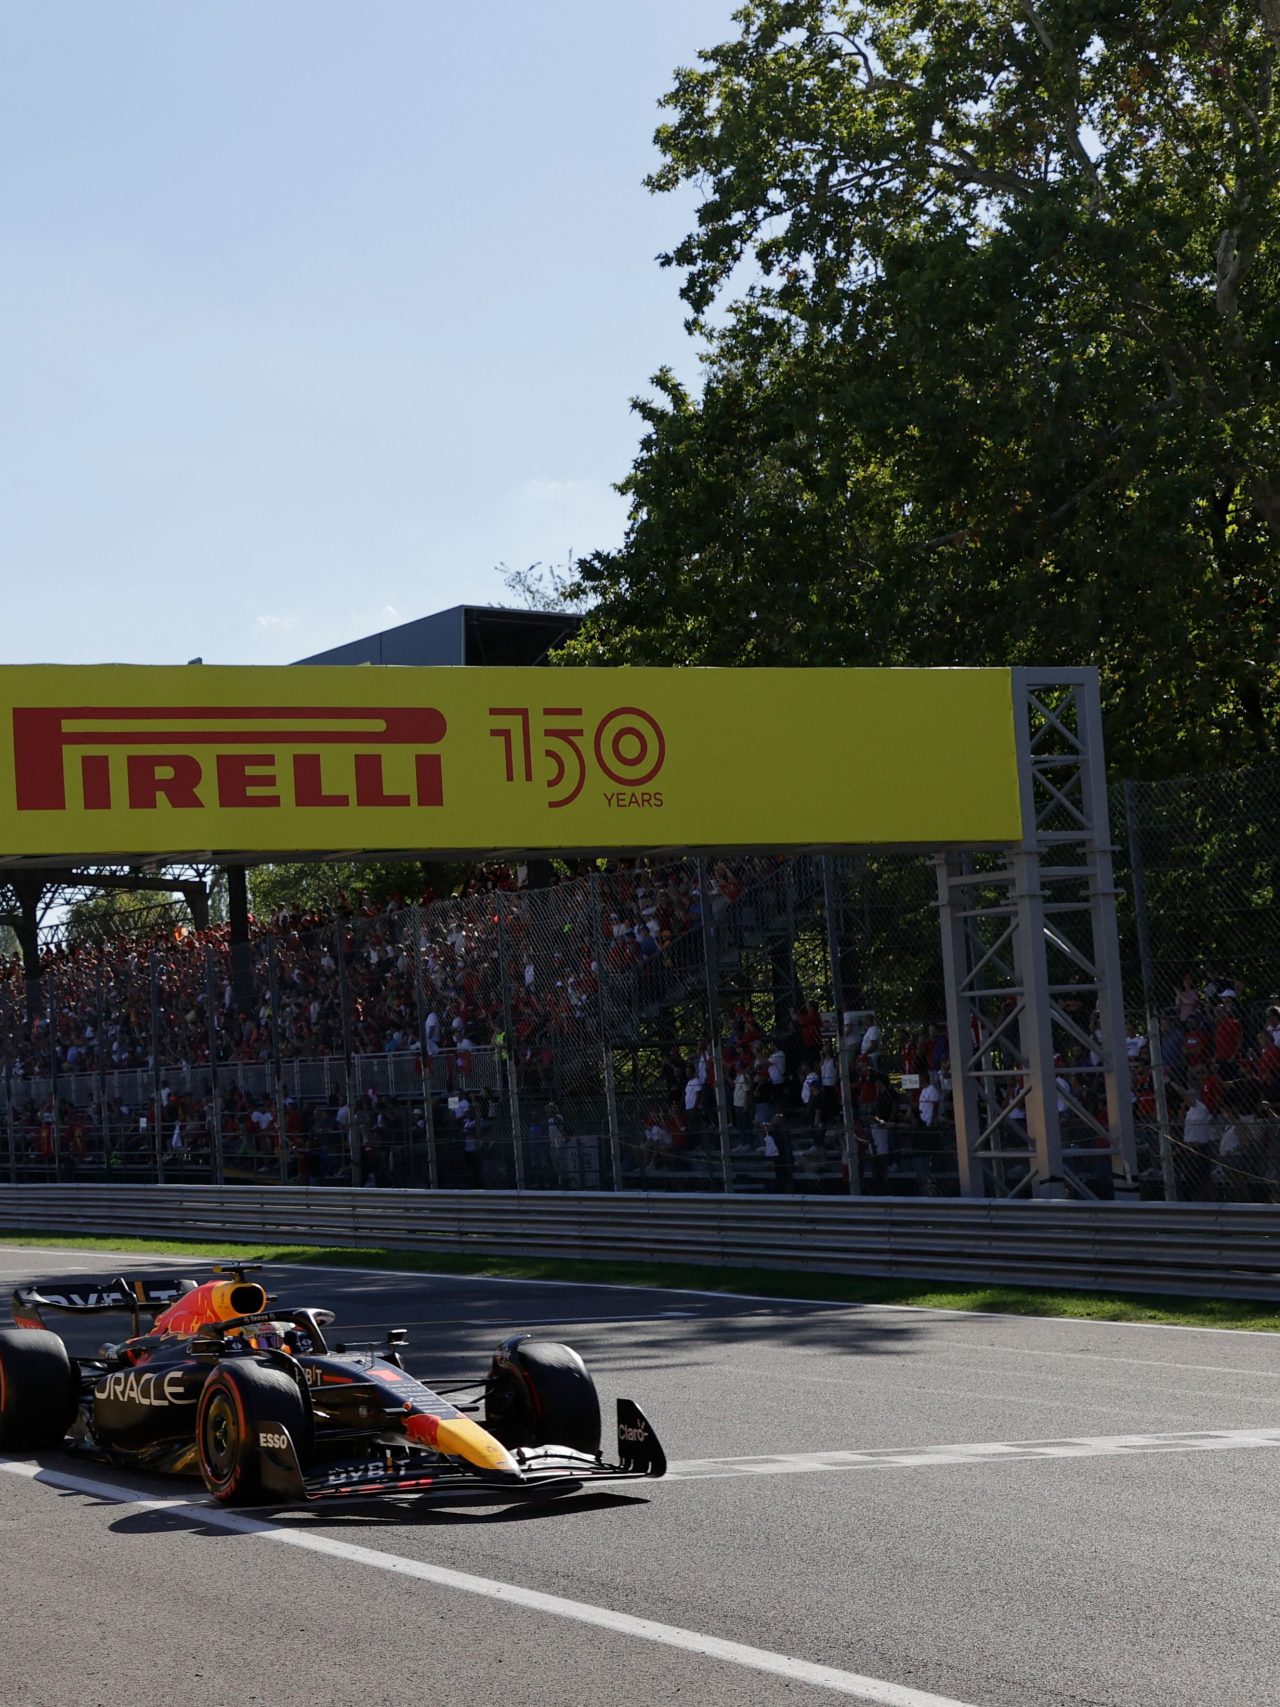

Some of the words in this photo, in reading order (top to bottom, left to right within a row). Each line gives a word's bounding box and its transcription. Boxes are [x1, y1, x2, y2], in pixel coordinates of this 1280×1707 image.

[12, 707, 447, 811] PIRELLI
[603, 792, 663, 808] YEARS
[95, 1371, 198, 1405] ORACLE
[259, 1433, 288, 1449] ESSO
[619, 1422, 646, 1442] Claro
